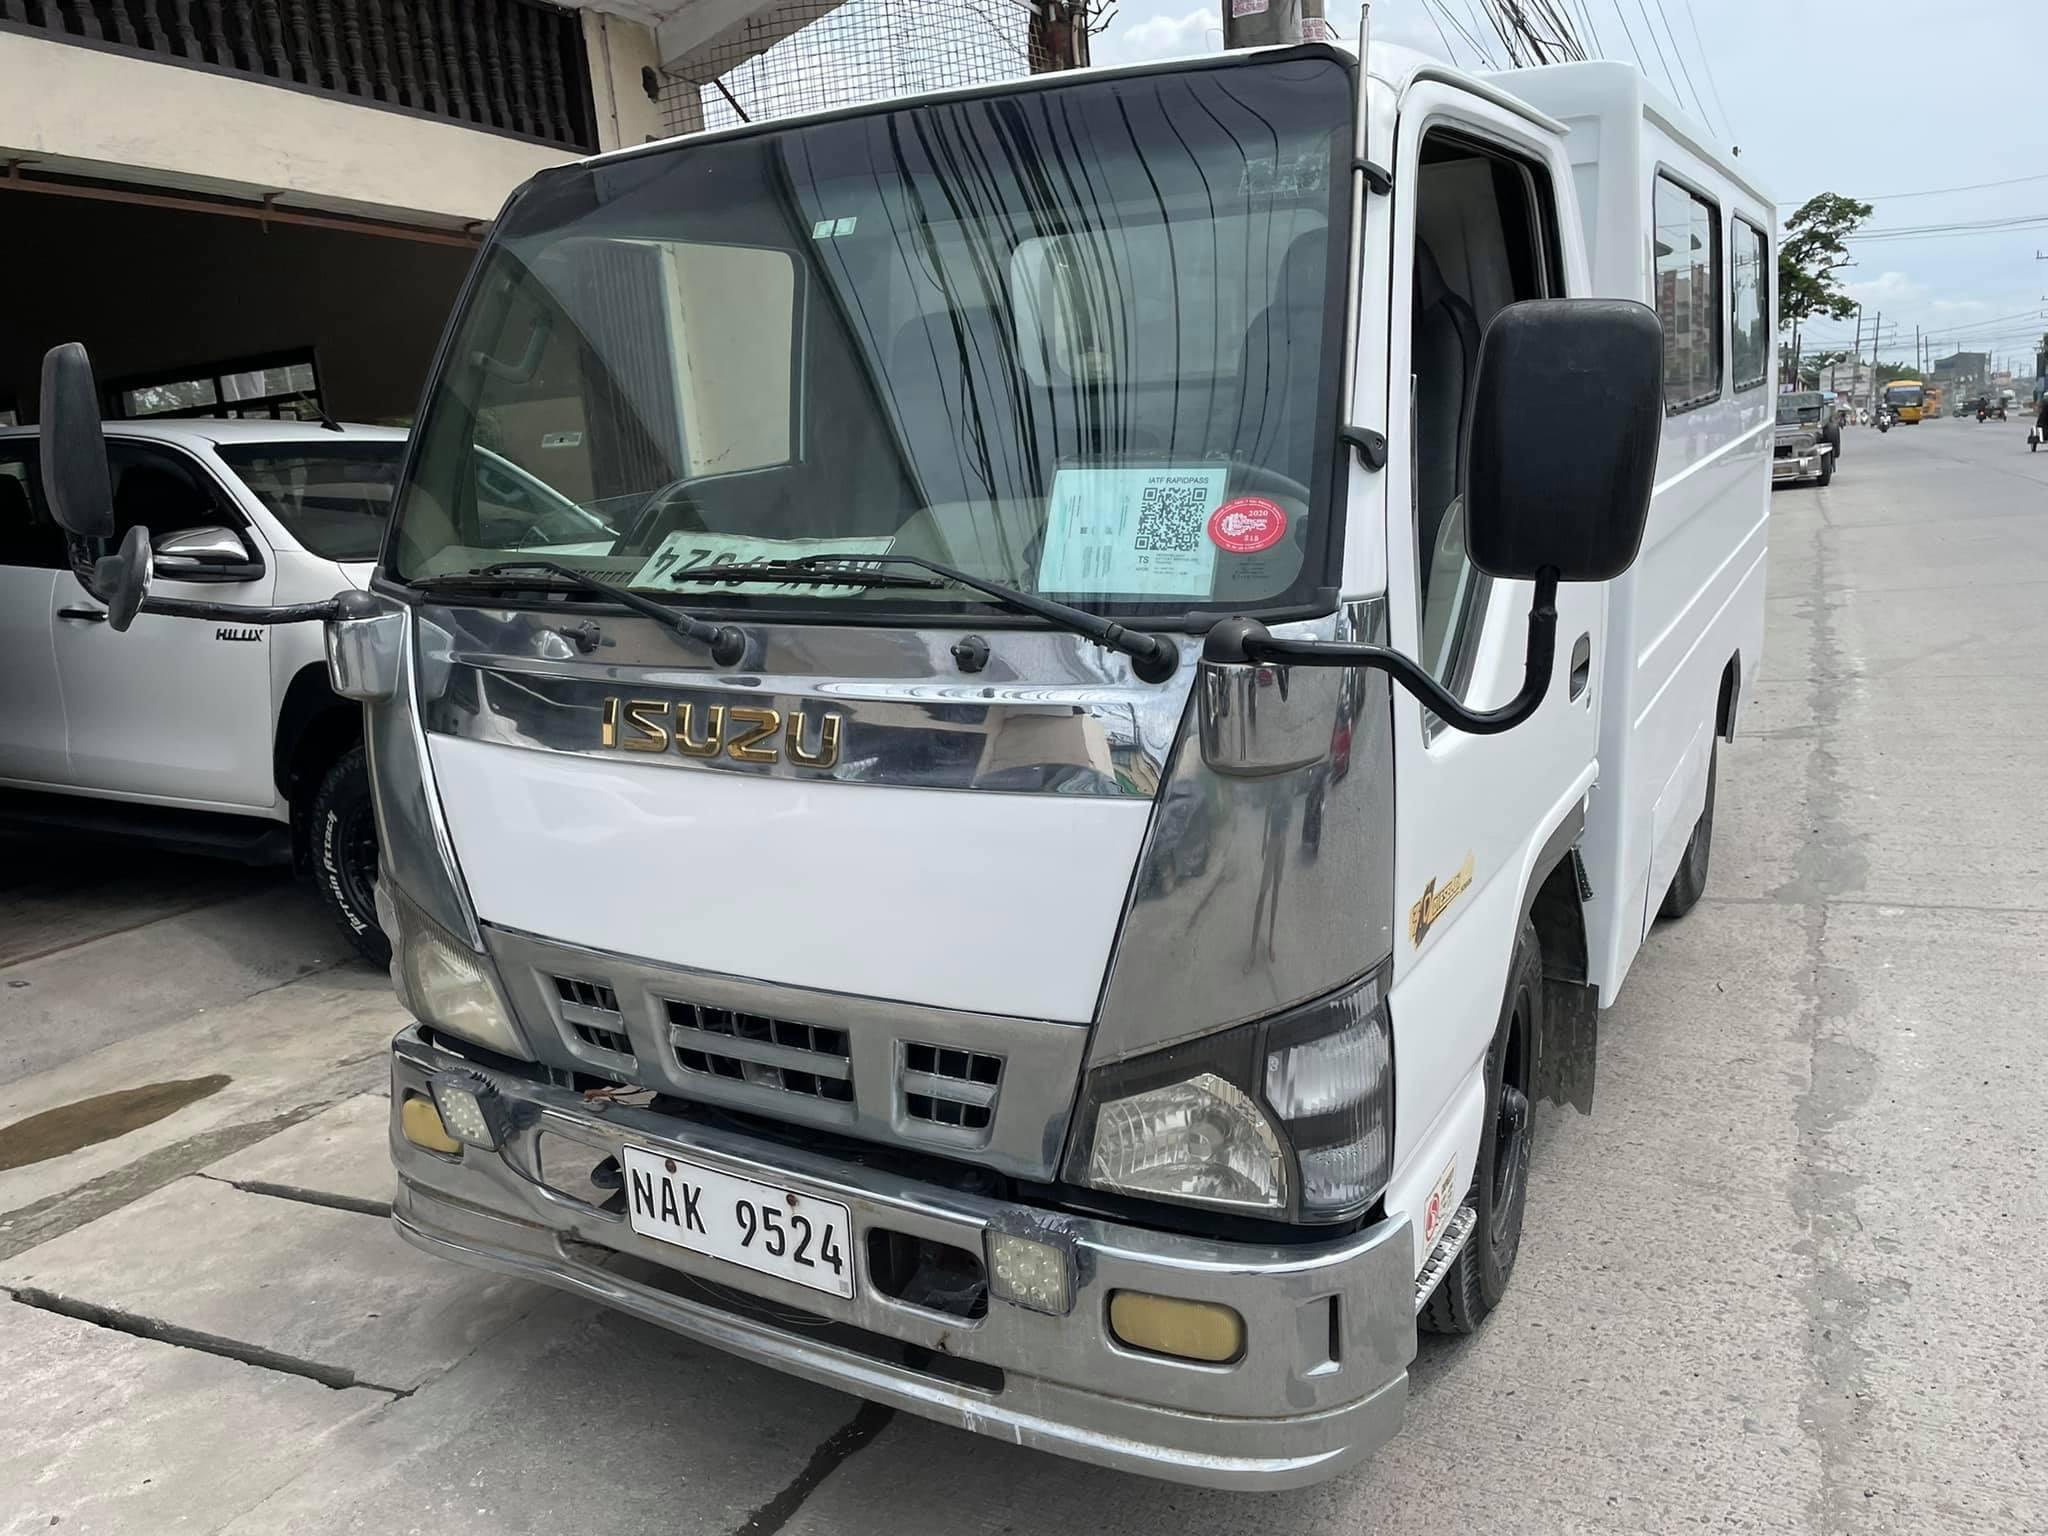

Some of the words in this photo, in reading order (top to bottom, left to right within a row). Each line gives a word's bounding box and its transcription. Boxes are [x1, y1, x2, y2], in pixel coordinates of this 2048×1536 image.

[1148, 476, 1165, 484] IATF
[1166, 476, 1209, 484] RAPIDPASS
[1247, 509, 1269, 517] 2020
[215, 627, 265, 642] HILUX
[600, 695, 843, 770] ISUZU
[322, 808, 339, 874] Attack
[328, 874, 369, 936] Terrain
[631, 1167, 707, 1235] NAK
[735, 1199, 844, 1276] 9524
